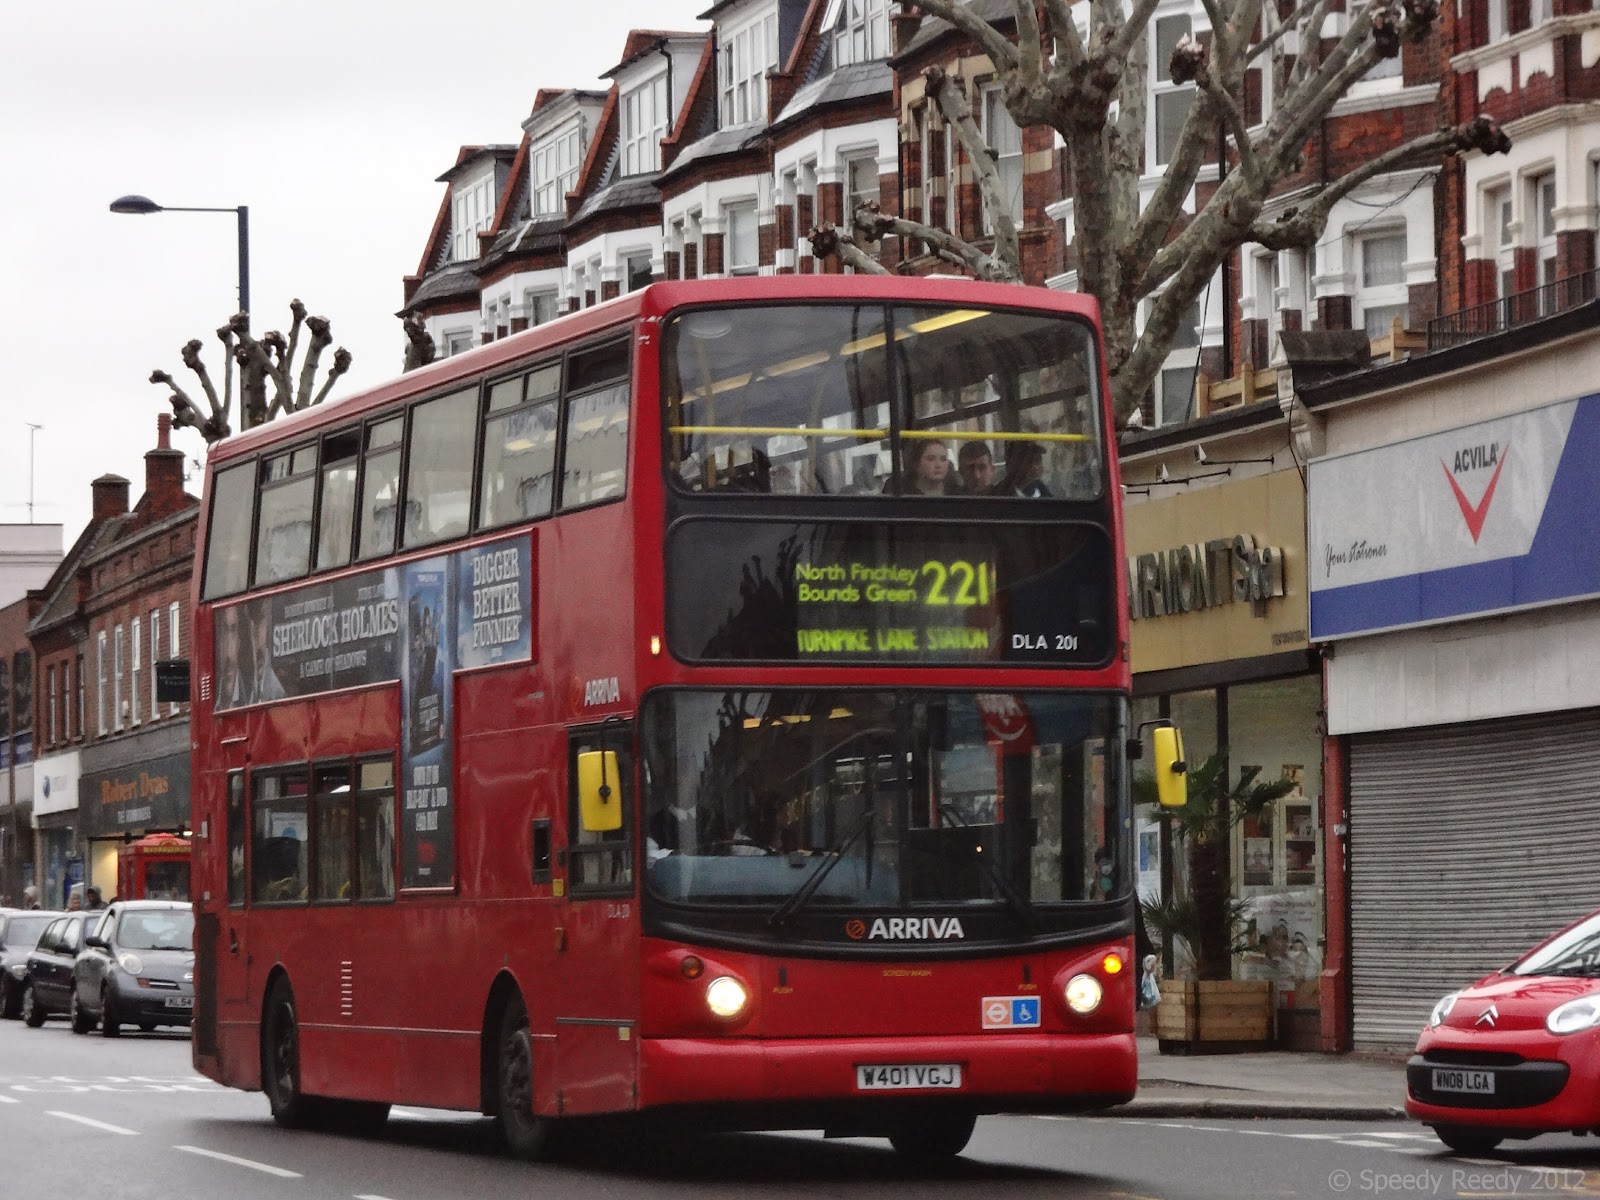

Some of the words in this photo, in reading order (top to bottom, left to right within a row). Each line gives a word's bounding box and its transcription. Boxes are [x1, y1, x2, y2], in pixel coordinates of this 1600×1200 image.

[473, 547, 520, 587] BIGGER
[796, 562, 846, 582] North
[851, 562, 919, 586] Finchley
[1325, 543, 1346, 578] Your
[1348, 539, 1388, 562] stationer
[798, 583, 860, 602] Bounds
[865, 583, 918, 602] Green
[922, 560, 989, 606] 221
[473, 581, 521, 620] BETTER
[272, 612, 339, 658] SHERLOCK
[341, 599, 399, 644] HOLMES
[473, 614, 522, 648] FUNNIER
[797, 629, 871, 652] TURNPIKE
[876, 629, 919, 651] LANE
[926, 627, 989, 651] STATION
[1012, 634, 1048, 650] DLA
[1055, 634, 1078, 651] 201
[584, 676, 620, 707] ARRIVA
[867, 917, 965, 940] ARRIVA
[1436, 1071, 1463, 1089] WN08
[1466, 1073, 1490, 1091] LGA
